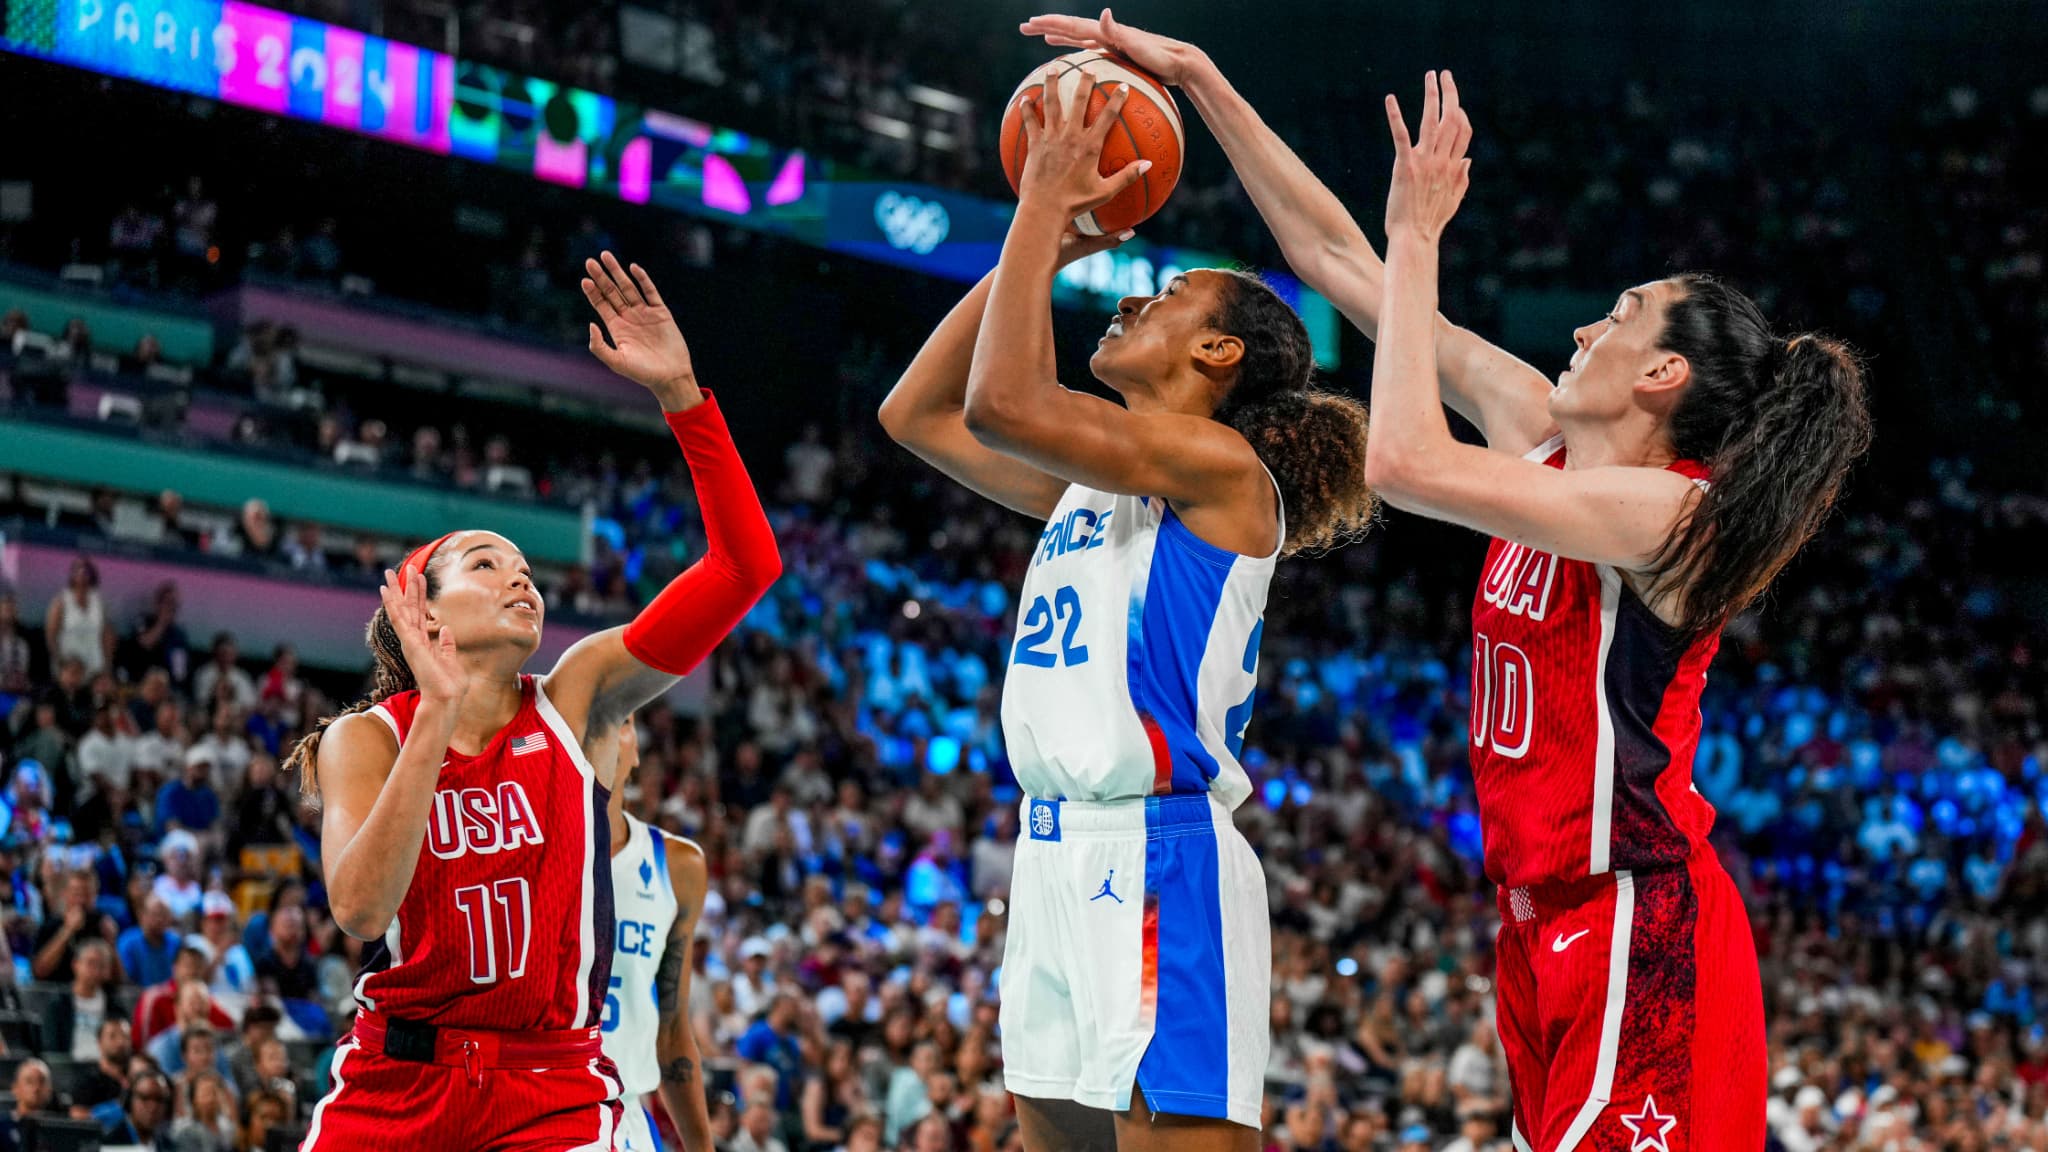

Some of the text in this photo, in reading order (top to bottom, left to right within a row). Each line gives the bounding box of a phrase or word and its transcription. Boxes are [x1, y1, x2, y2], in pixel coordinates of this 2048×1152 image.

[1014, 585, 1089, 668] 22
[1473, 631, 1534, 760] 10
[427, 781, 545, 860] USA
[455, 877, 532, 985] 11
